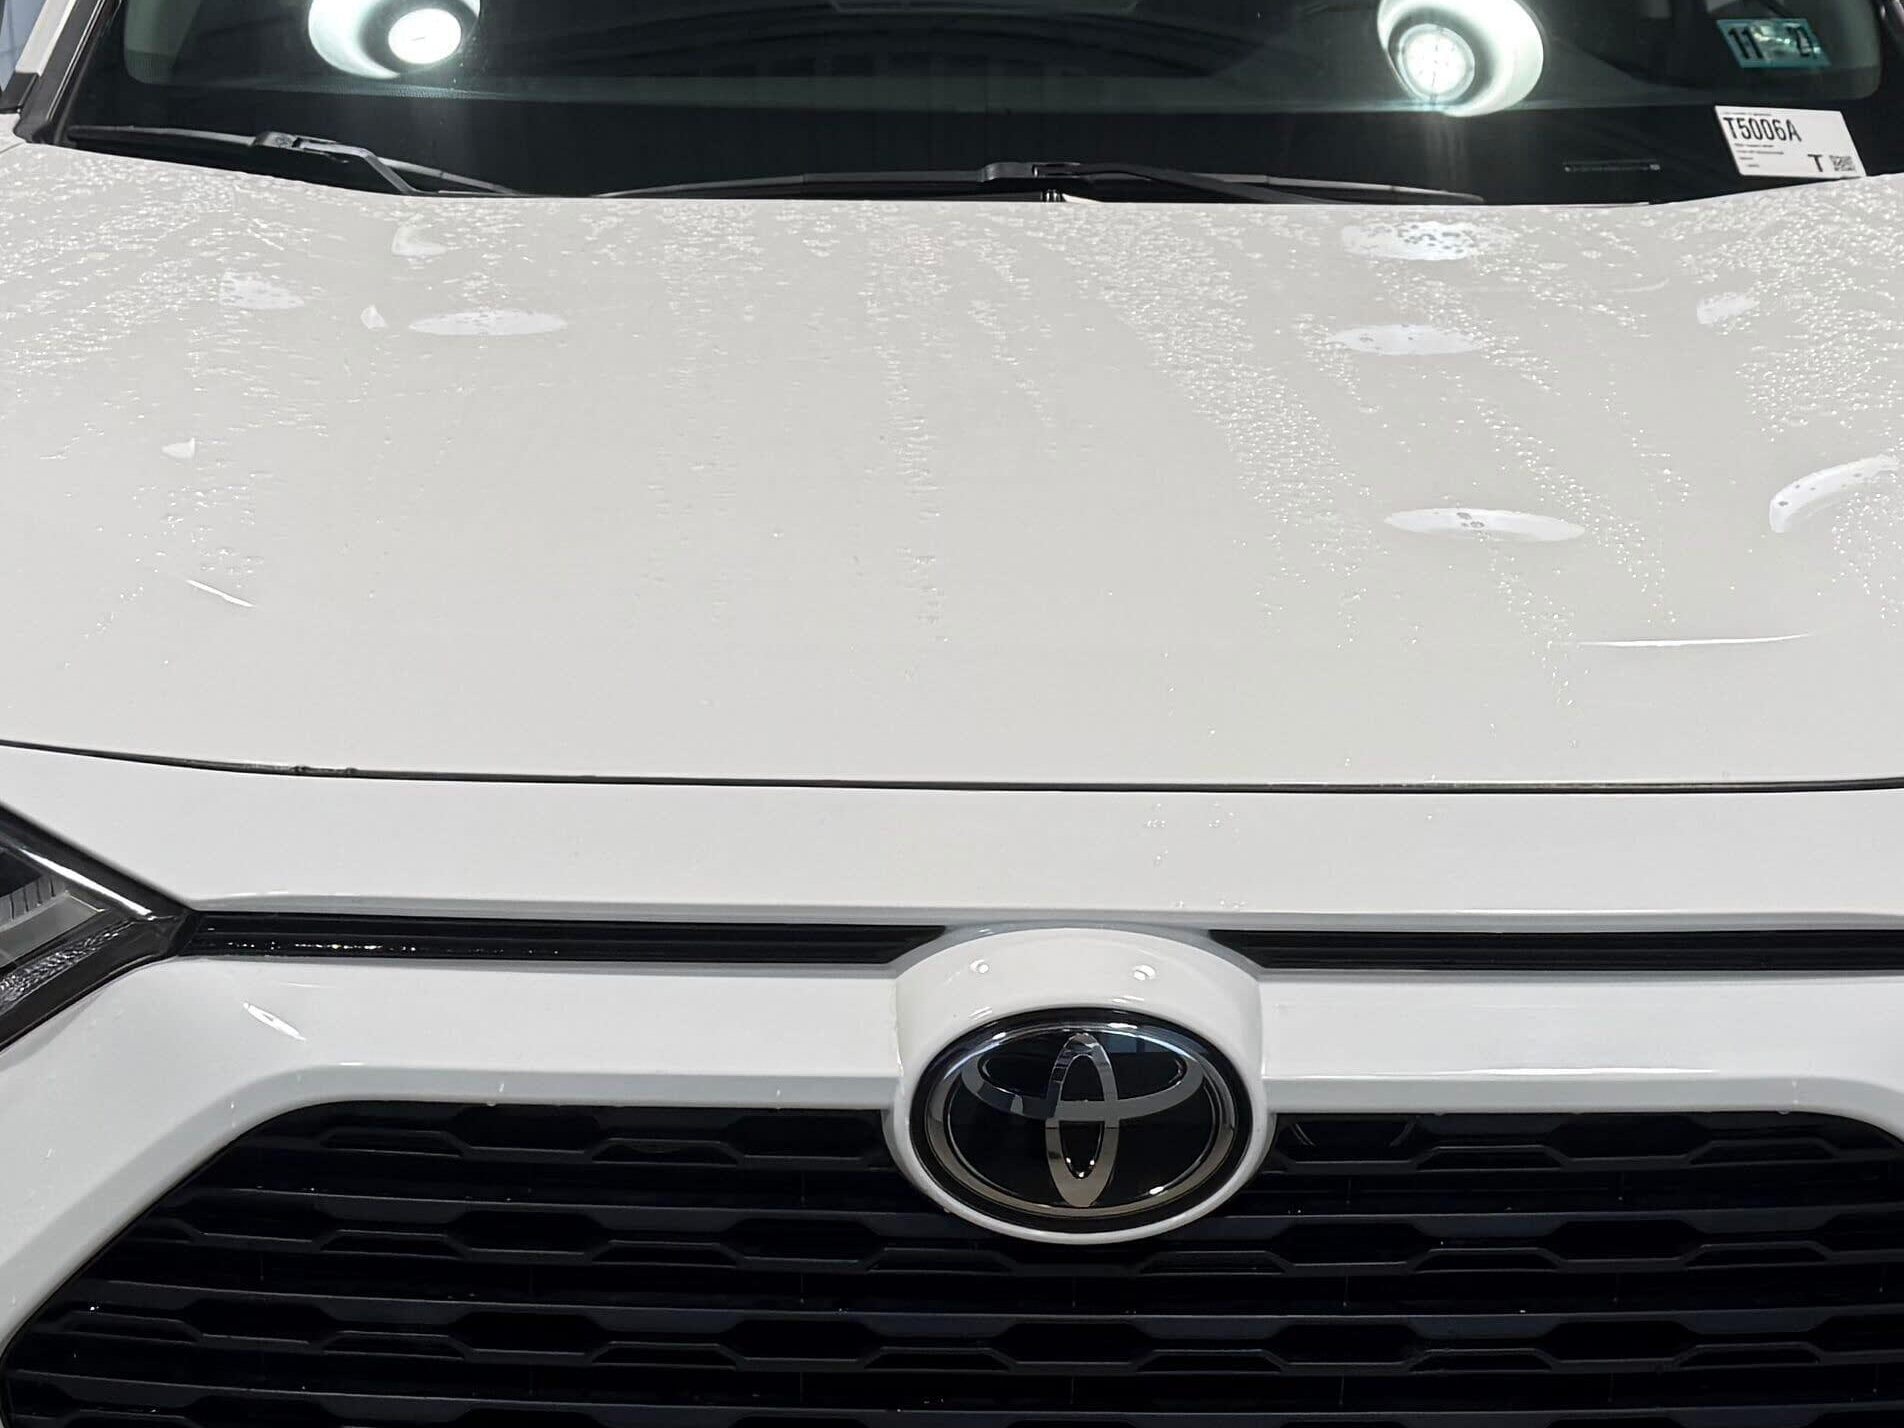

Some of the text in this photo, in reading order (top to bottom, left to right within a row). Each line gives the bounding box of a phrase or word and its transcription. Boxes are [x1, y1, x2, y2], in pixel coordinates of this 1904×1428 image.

[1728, 27, 1763, 59] 11
[1723, 117, 1802, 142] T5006A
[1807, 154, 1824, 172] T
